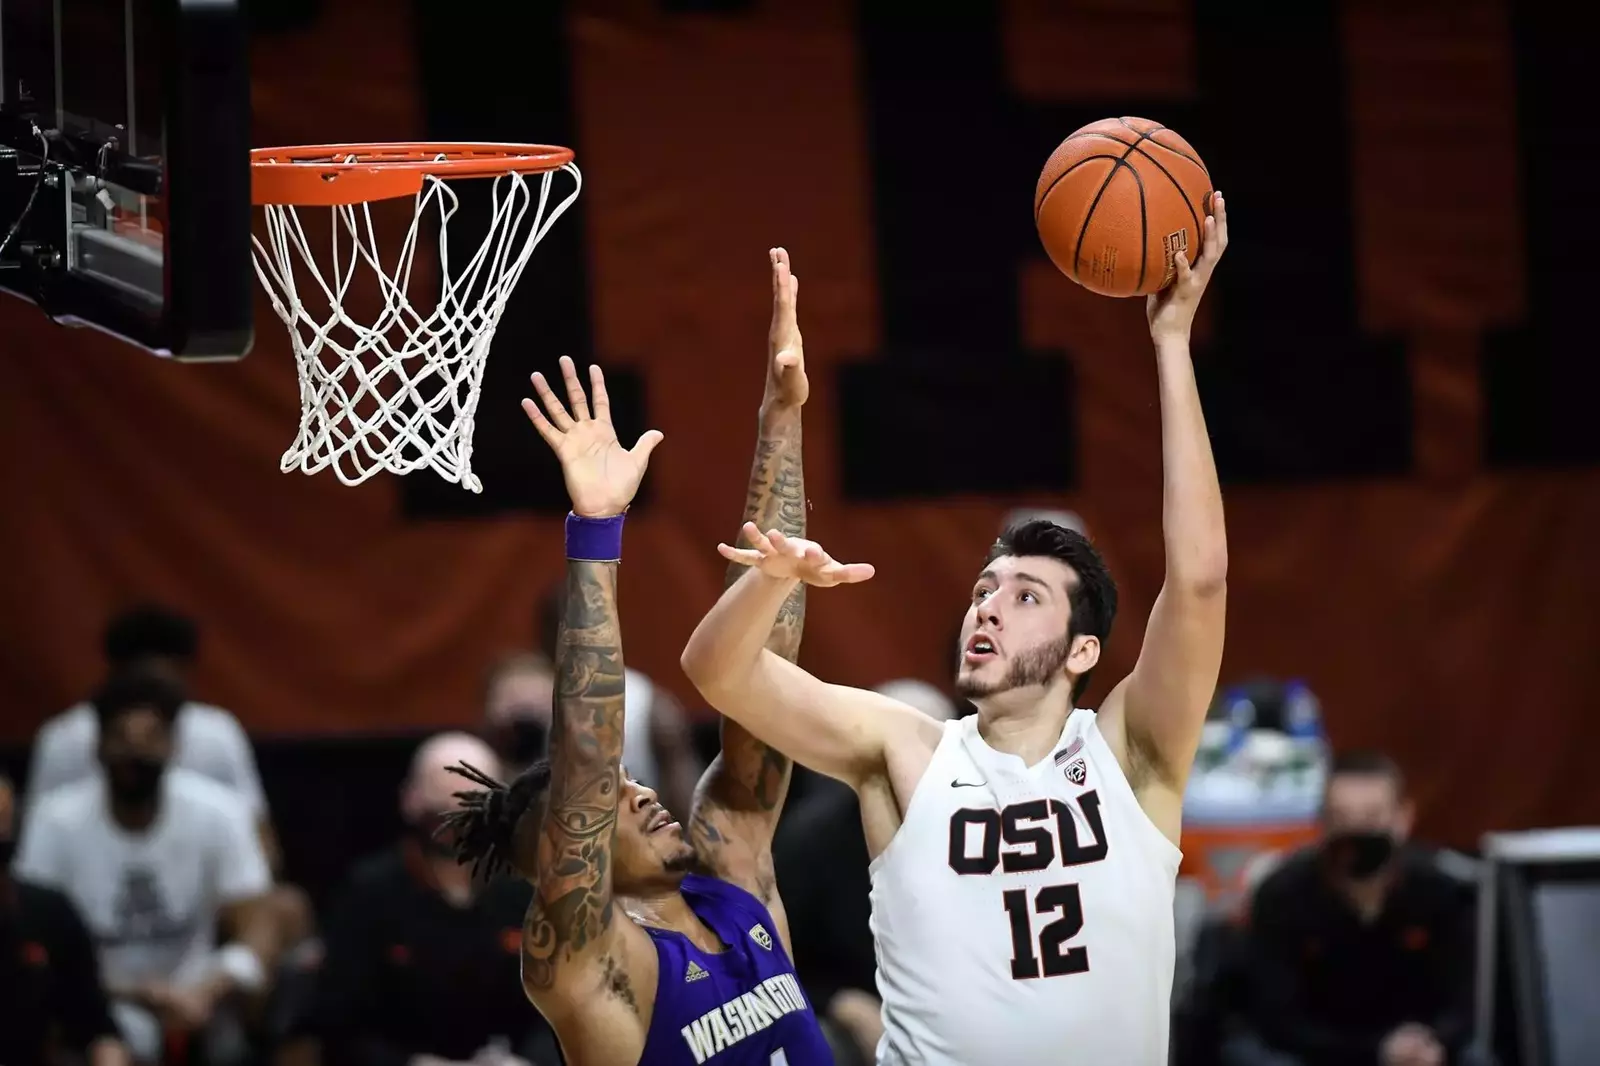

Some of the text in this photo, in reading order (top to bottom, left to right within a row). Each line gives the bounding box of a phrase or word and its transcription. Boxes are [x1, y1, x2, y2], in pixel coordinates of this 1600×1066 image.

[948, 789, 1108, 875] OSU
[1003, 883, 1090, 980] 12
[681, 973, 808, 1065] WASHNGTO
[685, 970, 709, 983] adidas
